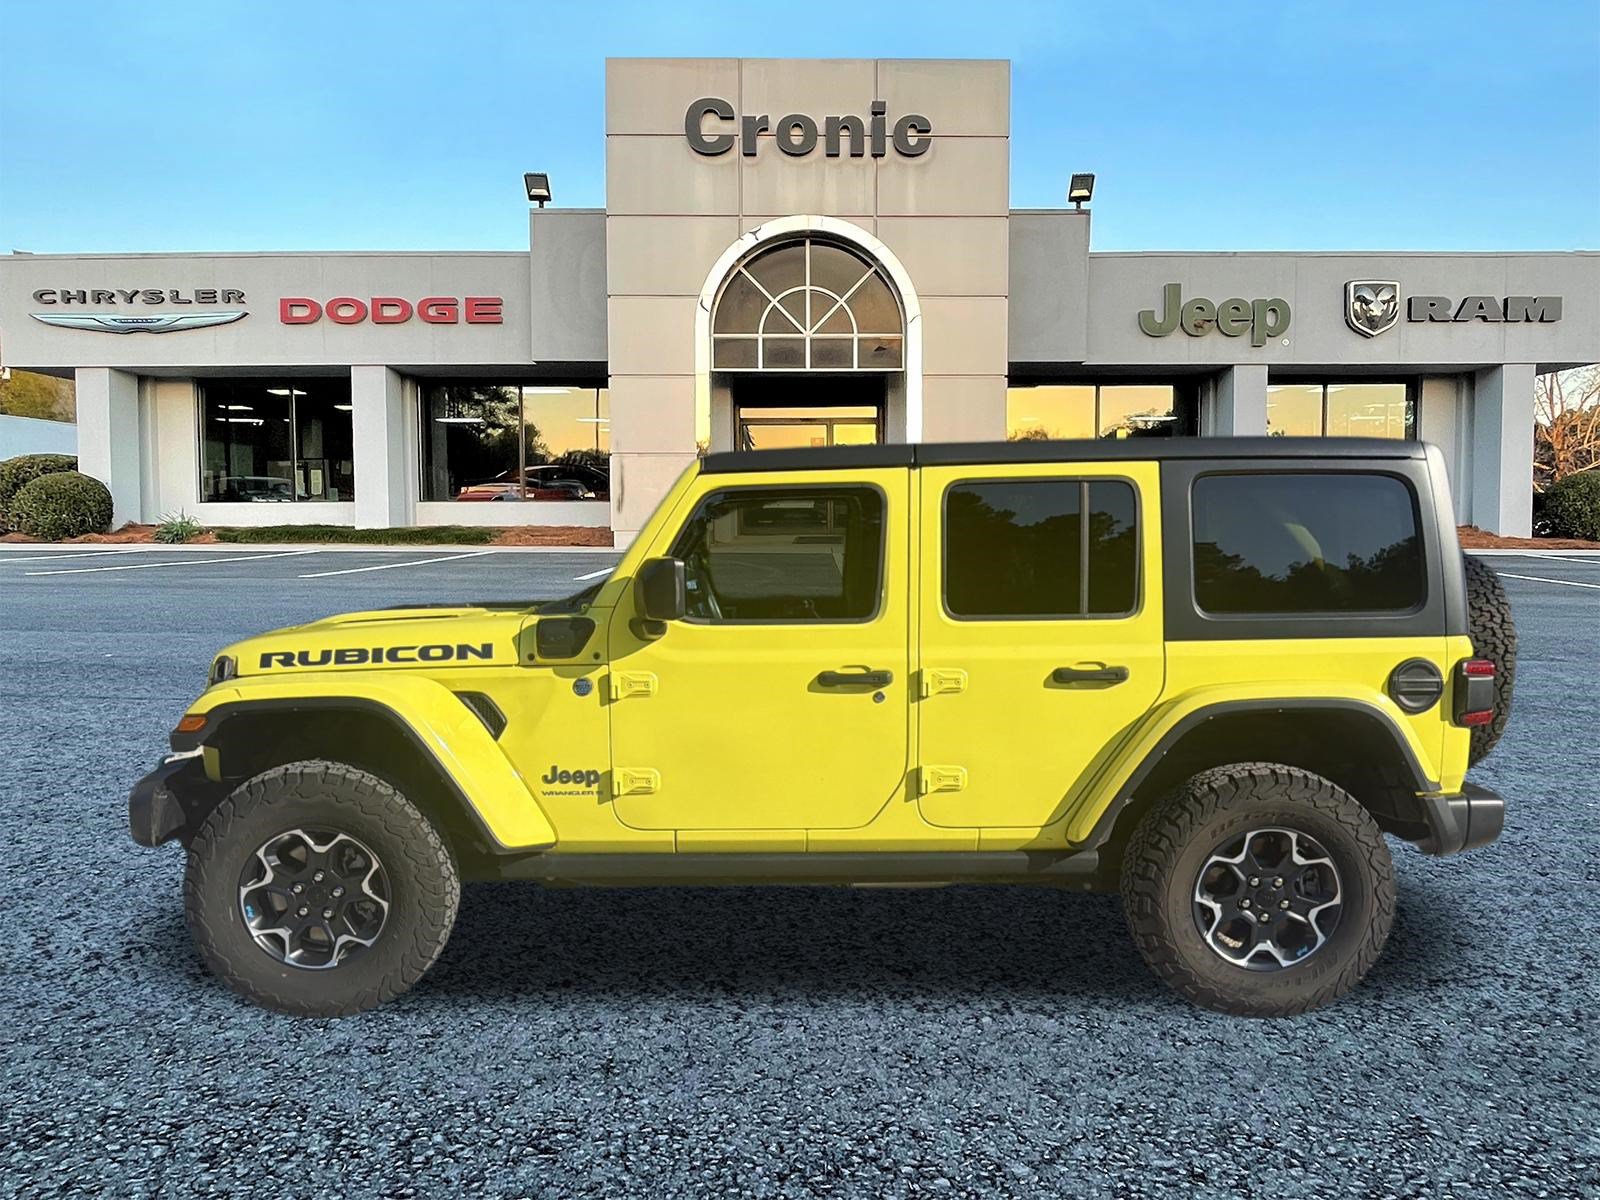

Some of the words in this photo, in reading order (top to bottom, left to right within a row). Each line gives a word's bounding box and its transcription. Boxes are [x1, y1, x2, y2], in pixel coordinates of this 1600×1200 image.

[684, 97, 933, 157] Cronic
[32, 288, 247, 305] CHRYSLER
[1407, 296, 1563, 323] RAM
[279, 297, 504, 325] DODGE
[1138, 282, 1291, 347] Jeep
[259, 643, 494, 668] RUBICON
[541, 765, 600, 788] Jeep
